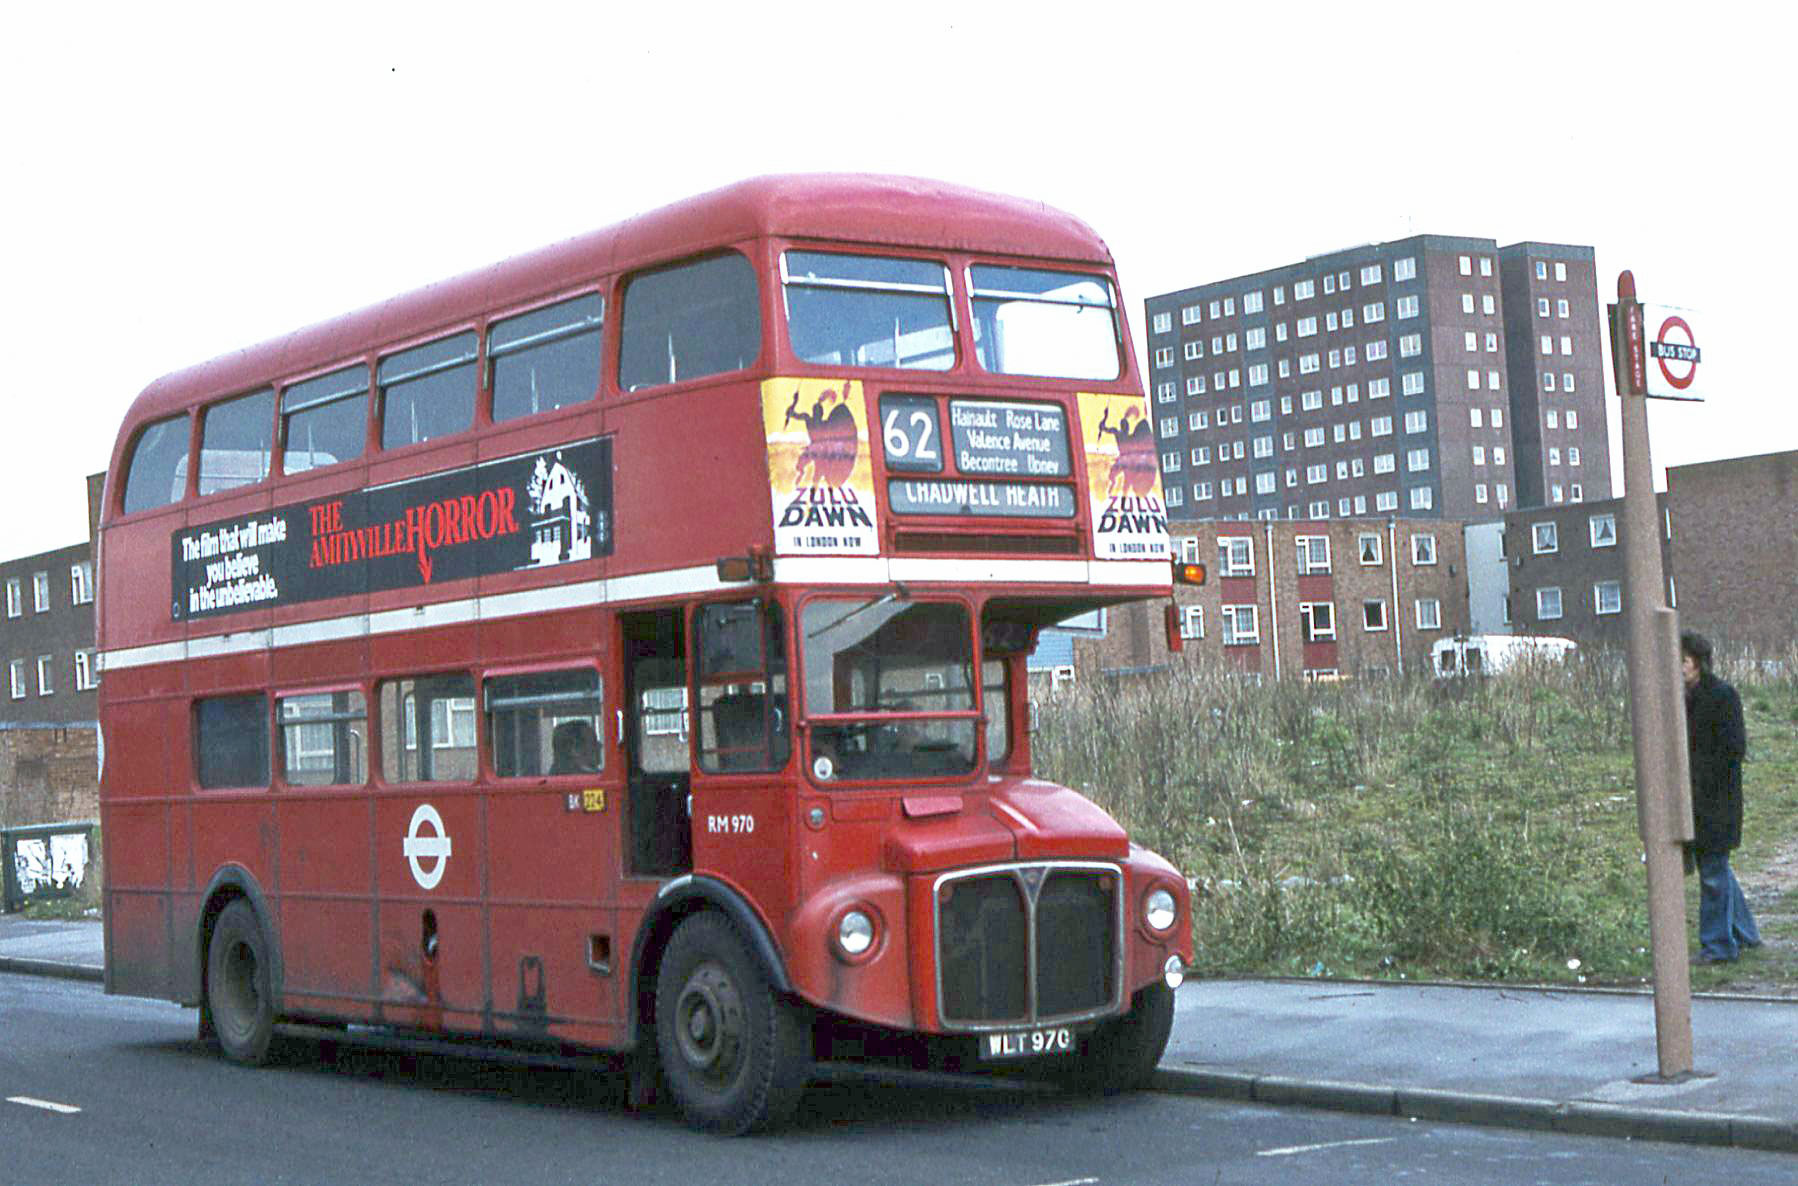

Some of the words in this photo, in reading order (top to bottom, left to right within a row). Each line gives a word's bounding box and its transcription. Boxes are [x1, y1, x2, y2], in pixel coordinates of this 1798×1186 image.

[1657, 343, 1675, 358] BUS
[951, 406, 998, 428] Hainault
[1006, 409, 1032, 430] Rose
[1034, 412, 1060, 432] Lane
[883, 409, 937, 459] 62
[966, 429, 1011, 450] Valence
[1013, 432, 1051, 452] Avenue
[960, 451, 1018, 473] Becontree
[789, 486, 859, 506] ZULU
[1105, 495, 1161, 513] ZULU
[308, 501, 344, 537] THE
[778, 505, 874, 529] DAWN
[1097, 513, 1169, 534] DAWN
[182, 536, 201, 563] The
[200, 532, 220, 559] film
[219, 524, 240, 554] that
[240, 521, 258, 550] will
[258, 516, 287, 546] make
[308, 519, 406, 569] AMITYVILLE
[404, 486, 520, 585] HORROR
[806, 536, 838, 548] LONDON
[206, 560, 225, 589] you
[224, 552, 260, 580] believe
[189, 587, 200, 613] in
[200, 585, 216, 612] the
[708, 815, 729, 833] RM
[731, 815, 754, 833] 970
[989, 1032, 1027, 1056] WLT
[1031, 1028, 1071, 1053] 970
